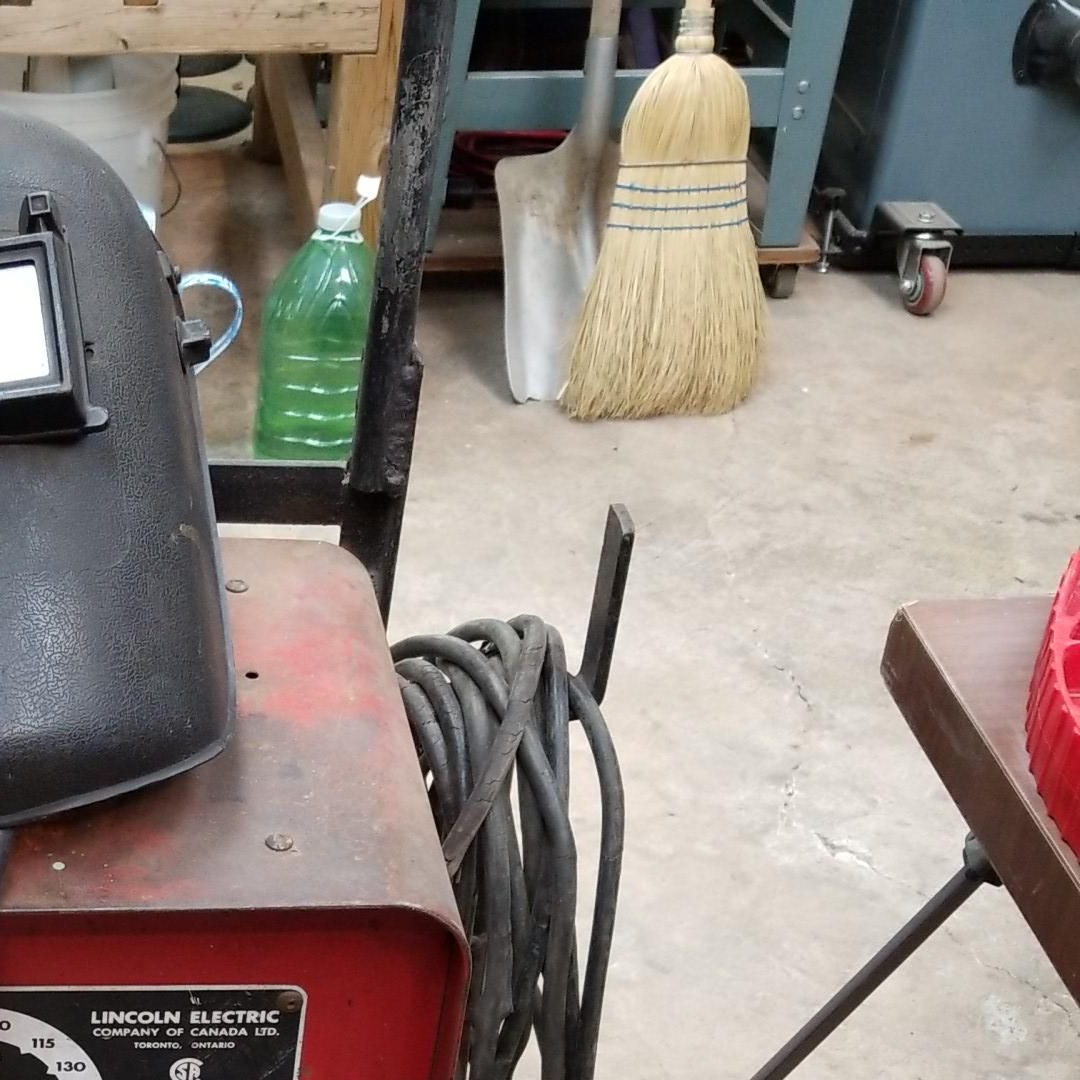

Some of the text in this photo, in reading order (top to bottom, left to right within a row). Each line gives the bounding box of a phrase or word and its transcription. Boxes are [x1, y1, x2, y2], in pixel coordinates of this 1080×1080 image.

[91, 1010, 280, 1024] LINCOLN ELECTRIC
[93, 1027, 280, 1037] COMPANY OF CANADA LTD.
[31, 1038, 56, 1048] 115
[133, 1041, 236, 1050] TORONTO, ONTARIO
[56, 1061, 86, 1072] 130
